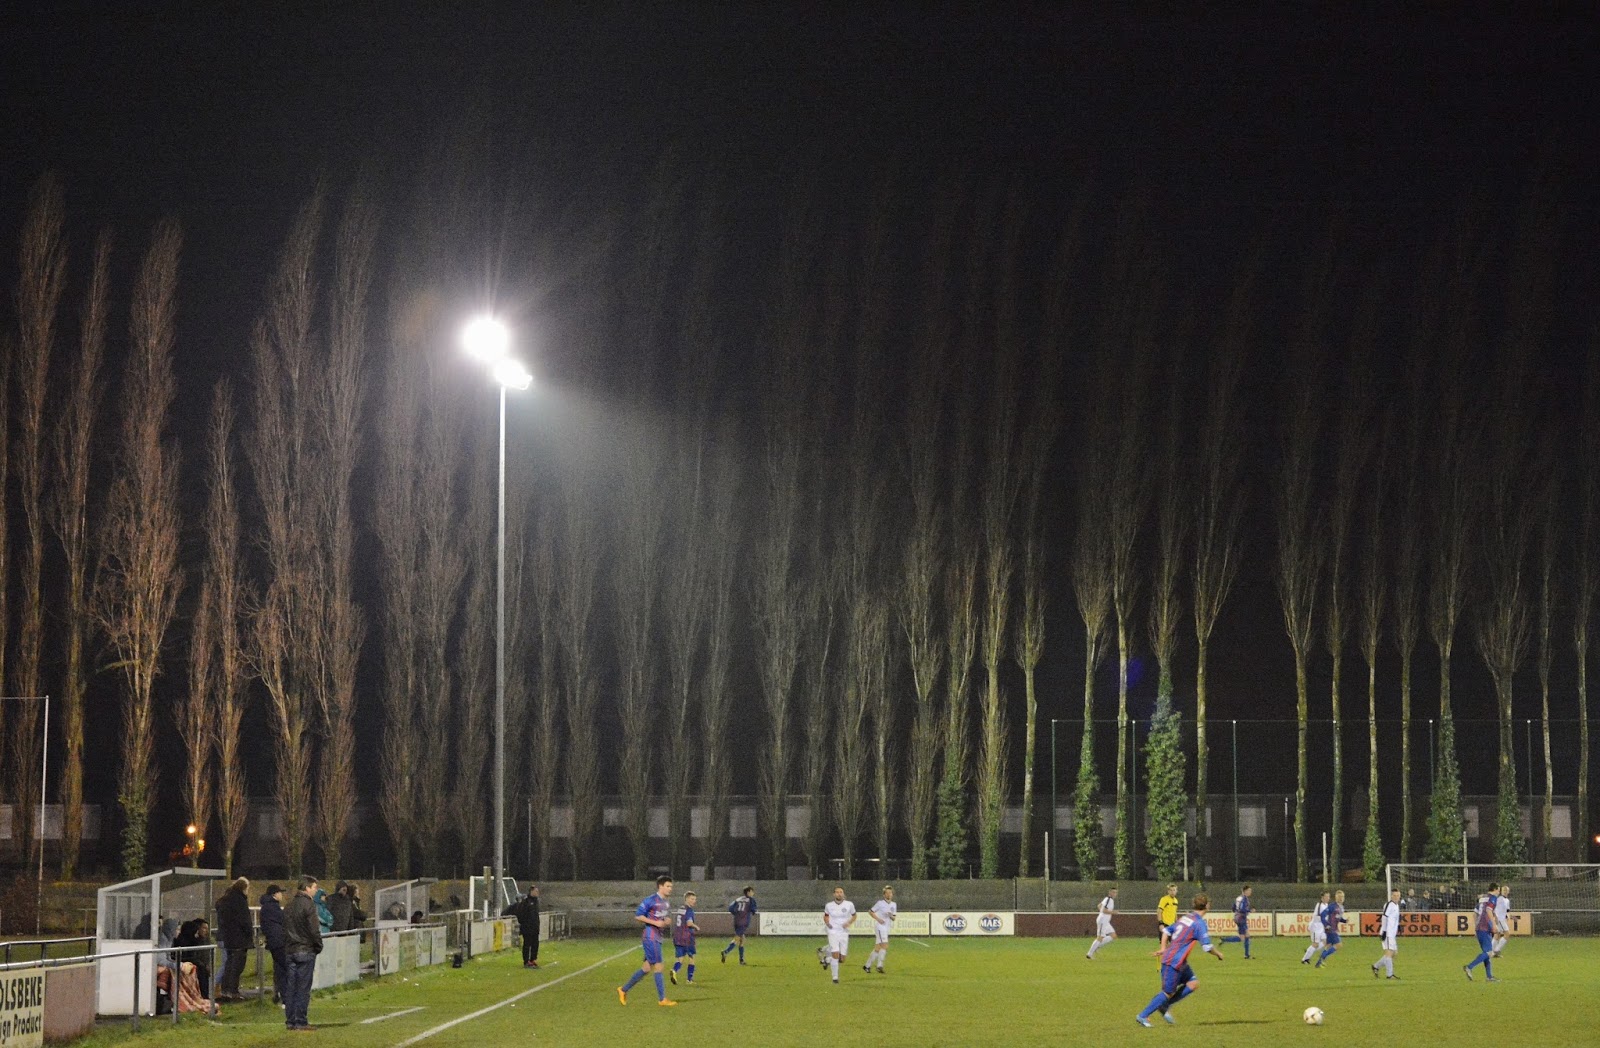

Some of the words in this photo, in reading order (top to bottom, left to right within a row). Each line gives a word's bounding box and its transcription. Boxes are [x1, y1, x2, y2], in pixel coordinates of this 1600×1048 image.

[1376, 914, 1431, 923] ZKEN
[944, 919, 966, 928] MAES
[980, 919, 1001, 928] MAES
[13, 1010, 41, 1036] Product
